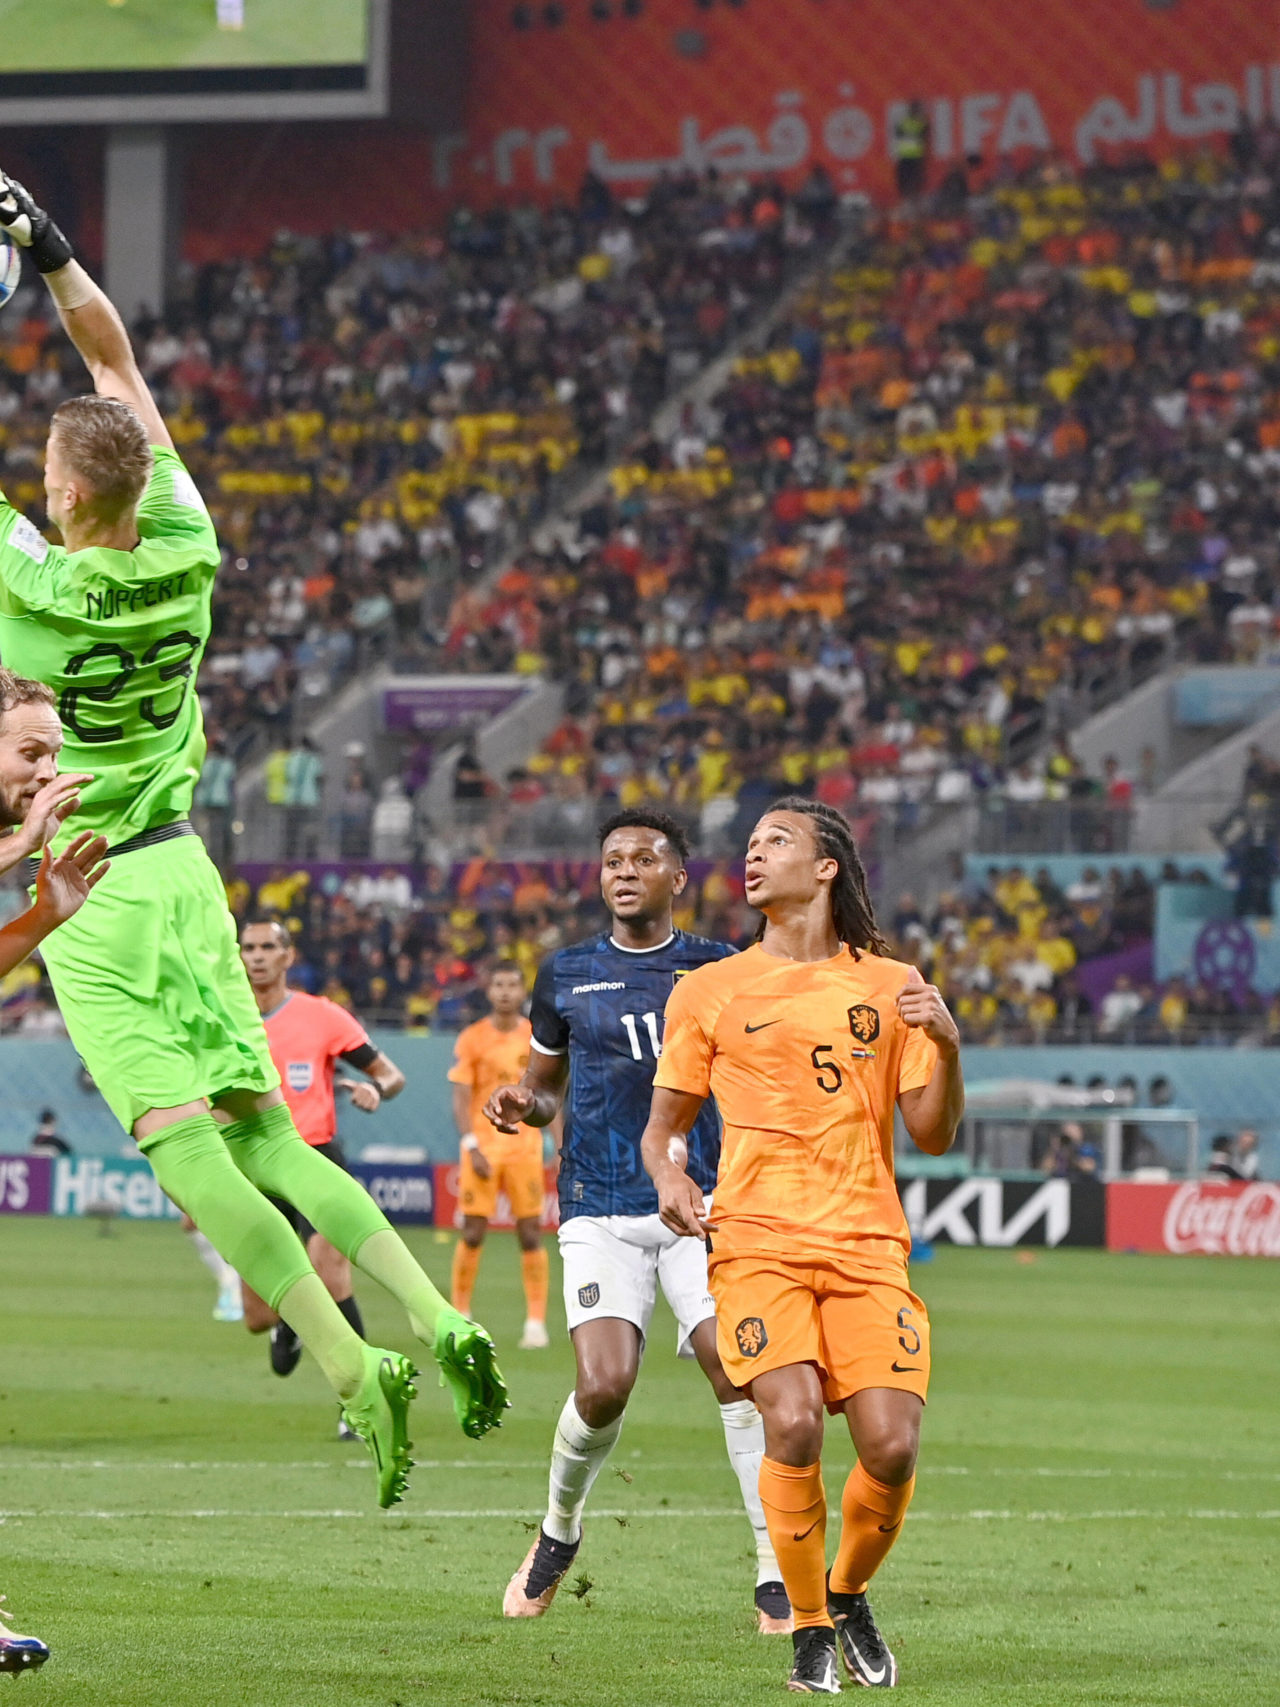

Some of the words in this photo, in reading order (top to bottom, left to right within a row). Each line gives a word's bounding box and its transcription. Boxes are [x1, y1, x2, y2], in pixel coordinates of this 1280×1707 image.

[86, 571, 189, 621] NOPPERT
[59, 630, 201, 743] 23
[572, 982, 625, 995] marathon
[620, 1012, 662, 1060] 11
[811, 1045, 842, 1093] 5
[52, 1157, 188, 1218] Hisen
[897, 1307, 920, 1355] 5
